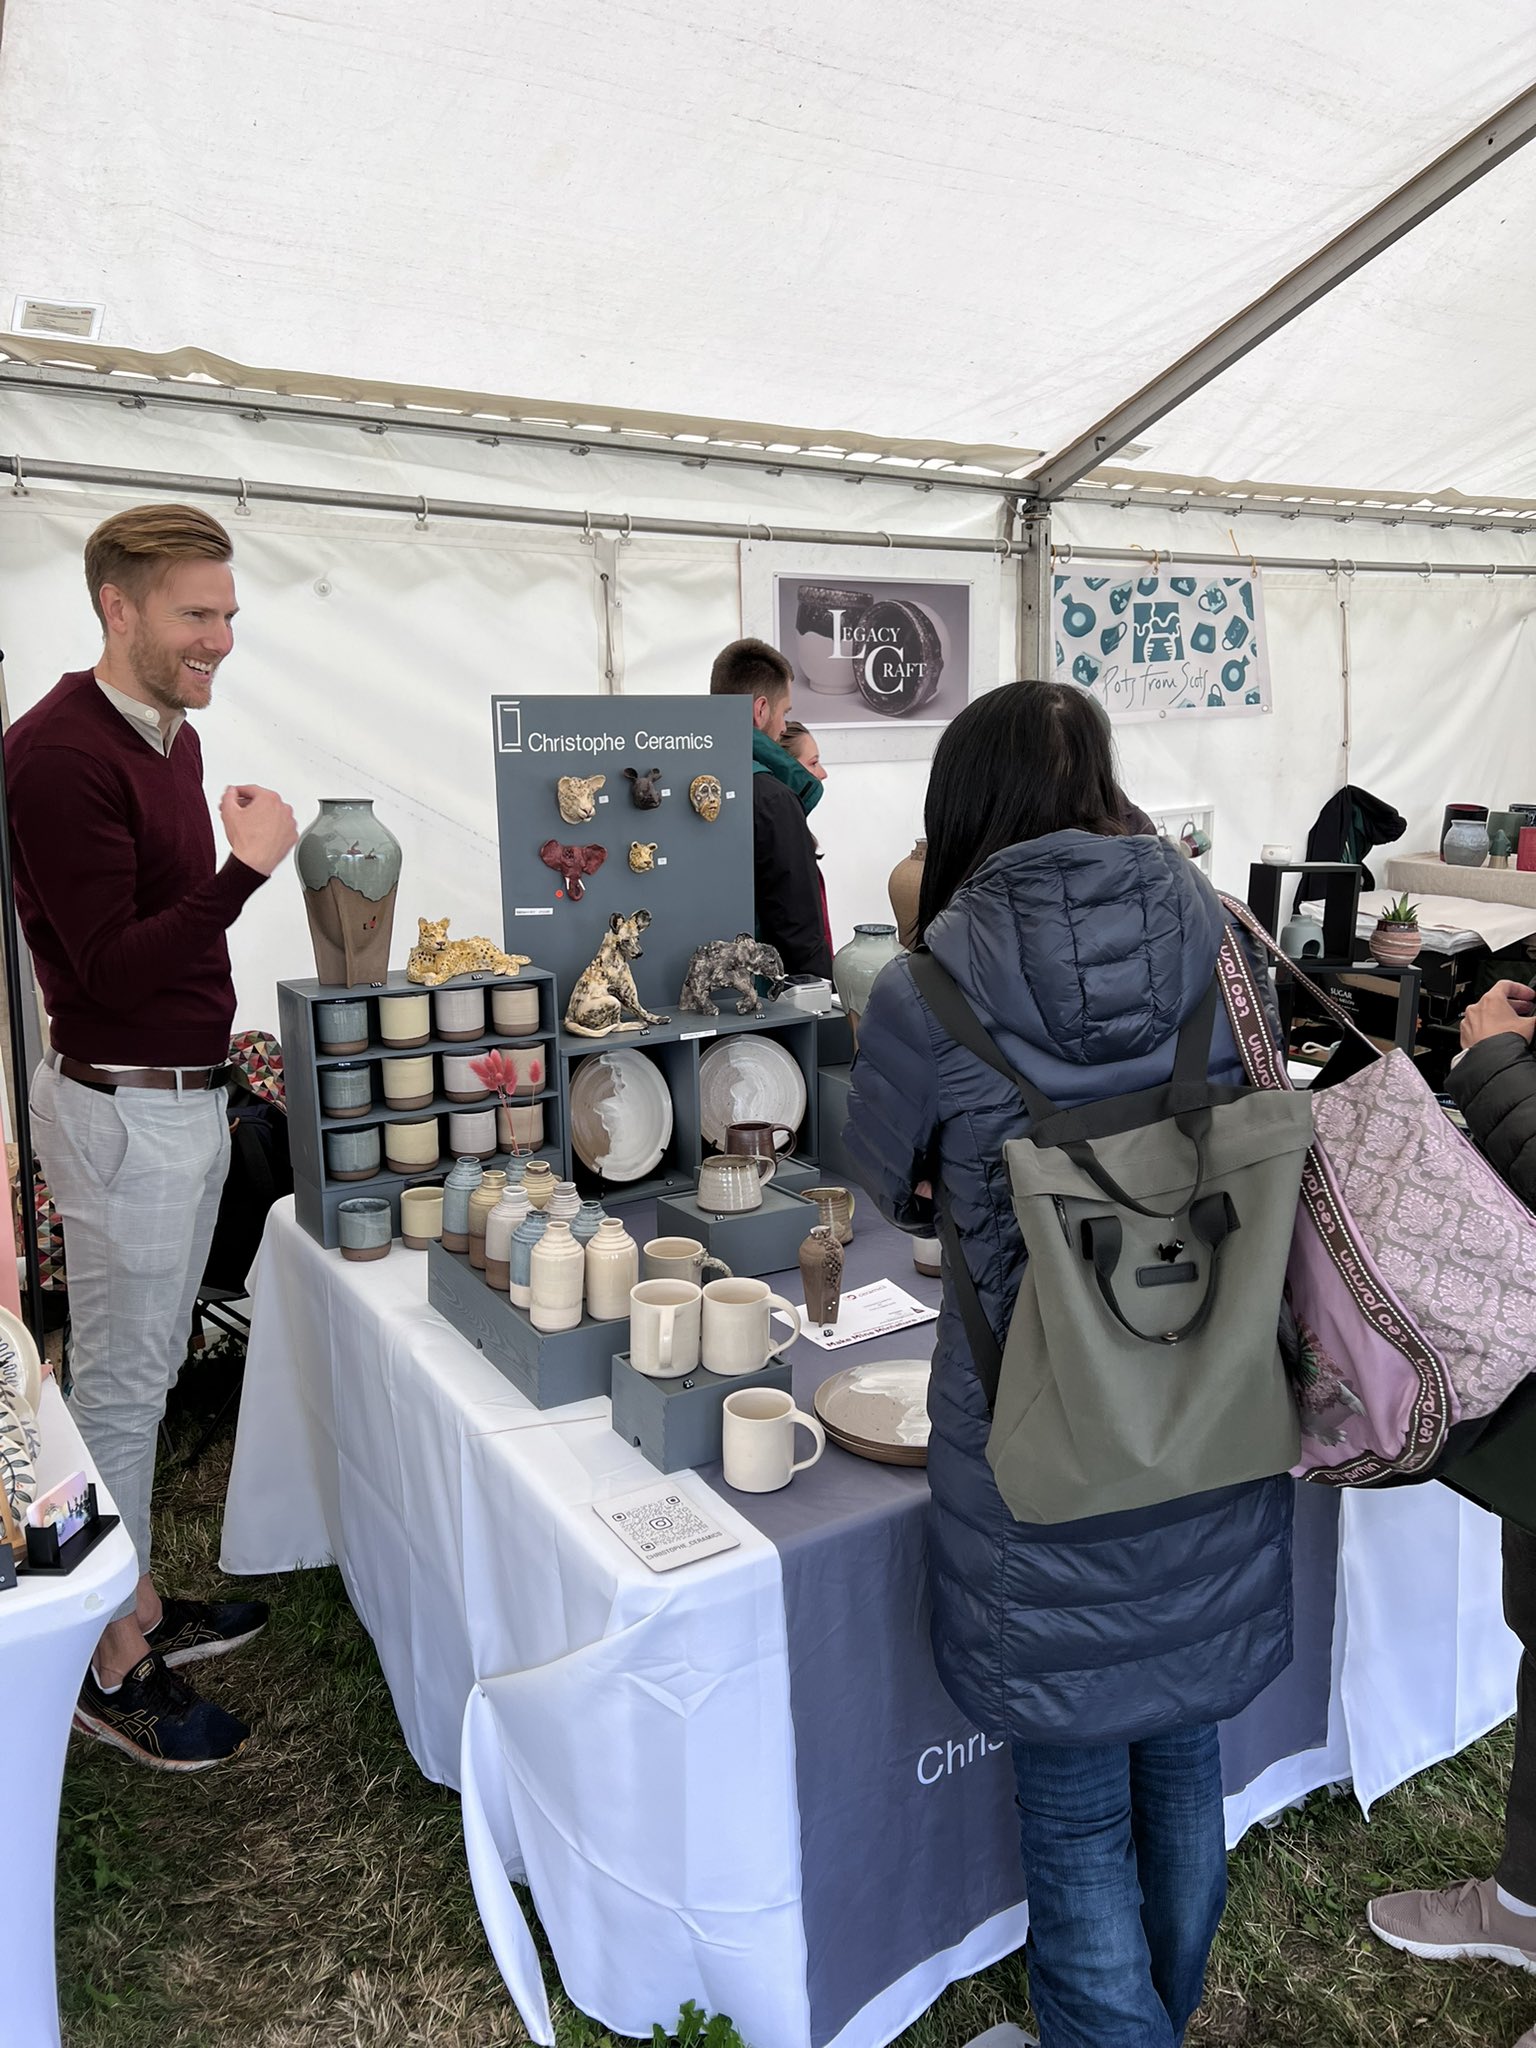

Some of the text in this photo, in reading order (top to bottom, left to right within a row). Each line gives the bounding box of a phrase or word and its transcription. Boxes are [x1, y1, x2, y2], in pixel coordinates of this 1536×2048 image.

[827, 609, 901, 659] LEGACY
[864, 645, 928, 694] CRAFT
[1103, 665, 1136, 709] Pots
[1140, 664, 1177, 706] from
[528, 731, 713, 756] Christophe Ceramics
[1330, 987, 1352, 999] SUGAR
[826, 1339, 852, 1347] Make
[852, 1332, 875, 1340] Mine
[645, 1531, 723, 1560] CHRISTOPHE_CERAMICS
